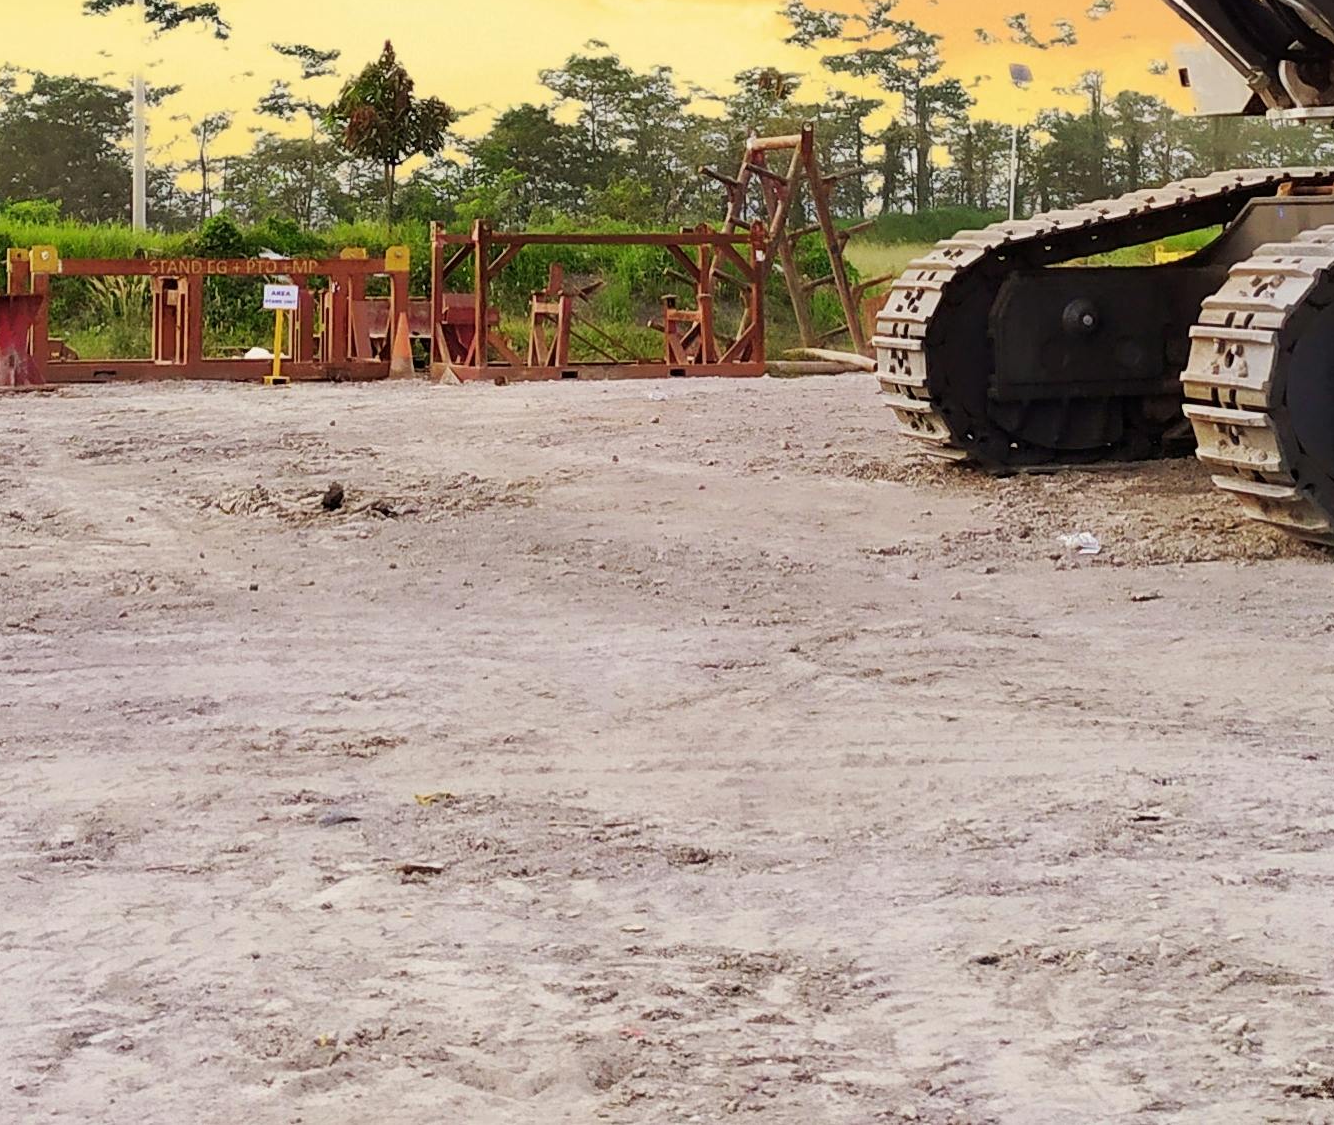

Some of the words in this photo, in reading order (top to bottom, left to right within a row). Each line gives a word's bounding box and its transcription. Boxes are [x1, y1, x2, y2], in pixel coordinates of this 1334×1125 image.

[149, 260, 202, 274] STAND
[207, 260, 228, 274] EG
[246, 259, 277, 273] PTO
